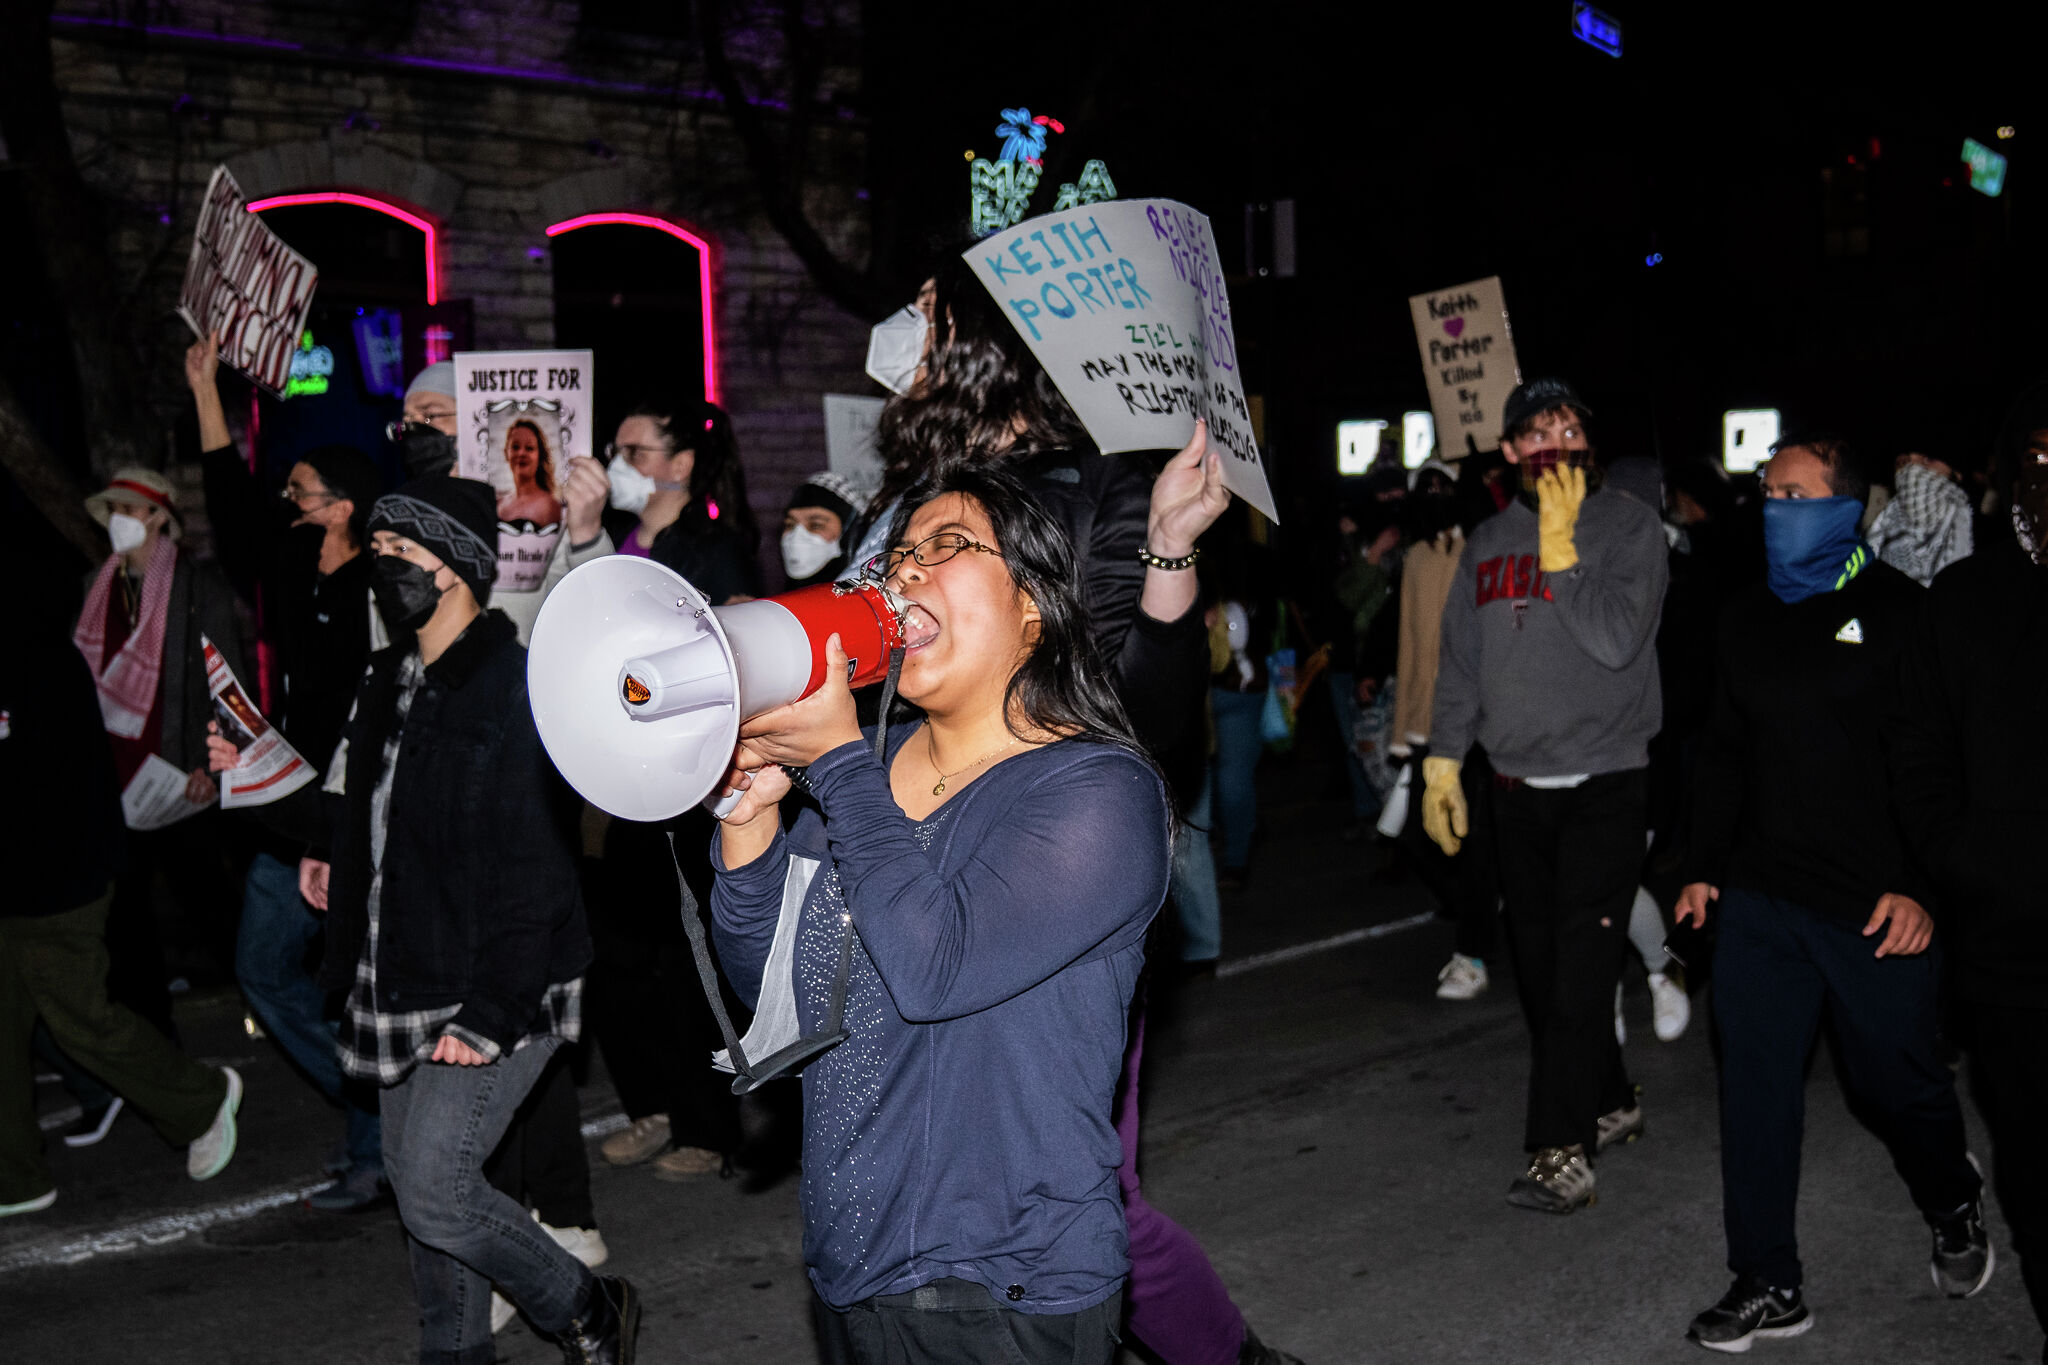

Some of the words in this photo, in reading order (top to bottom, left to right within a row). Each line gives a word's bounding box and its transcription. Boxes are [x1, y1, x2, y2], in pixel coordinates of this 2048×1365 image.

[985, 216, 1112, 286] KEITH
[1009, 257, 1152, 341] PORTER
[1427, 293, 1479, 320] Keith
[237, 309, 294, 389] GOOD
[1429, 335, 1493, 366] Porter
[469, 369, 537, 392] JUSTICE
[547, 367, 580, 391] FOR
[1080, 353, 1130, 382] MAY
[1132, 351, 1173, 378] THE
[1440, 363, 1484, 386] Killed
